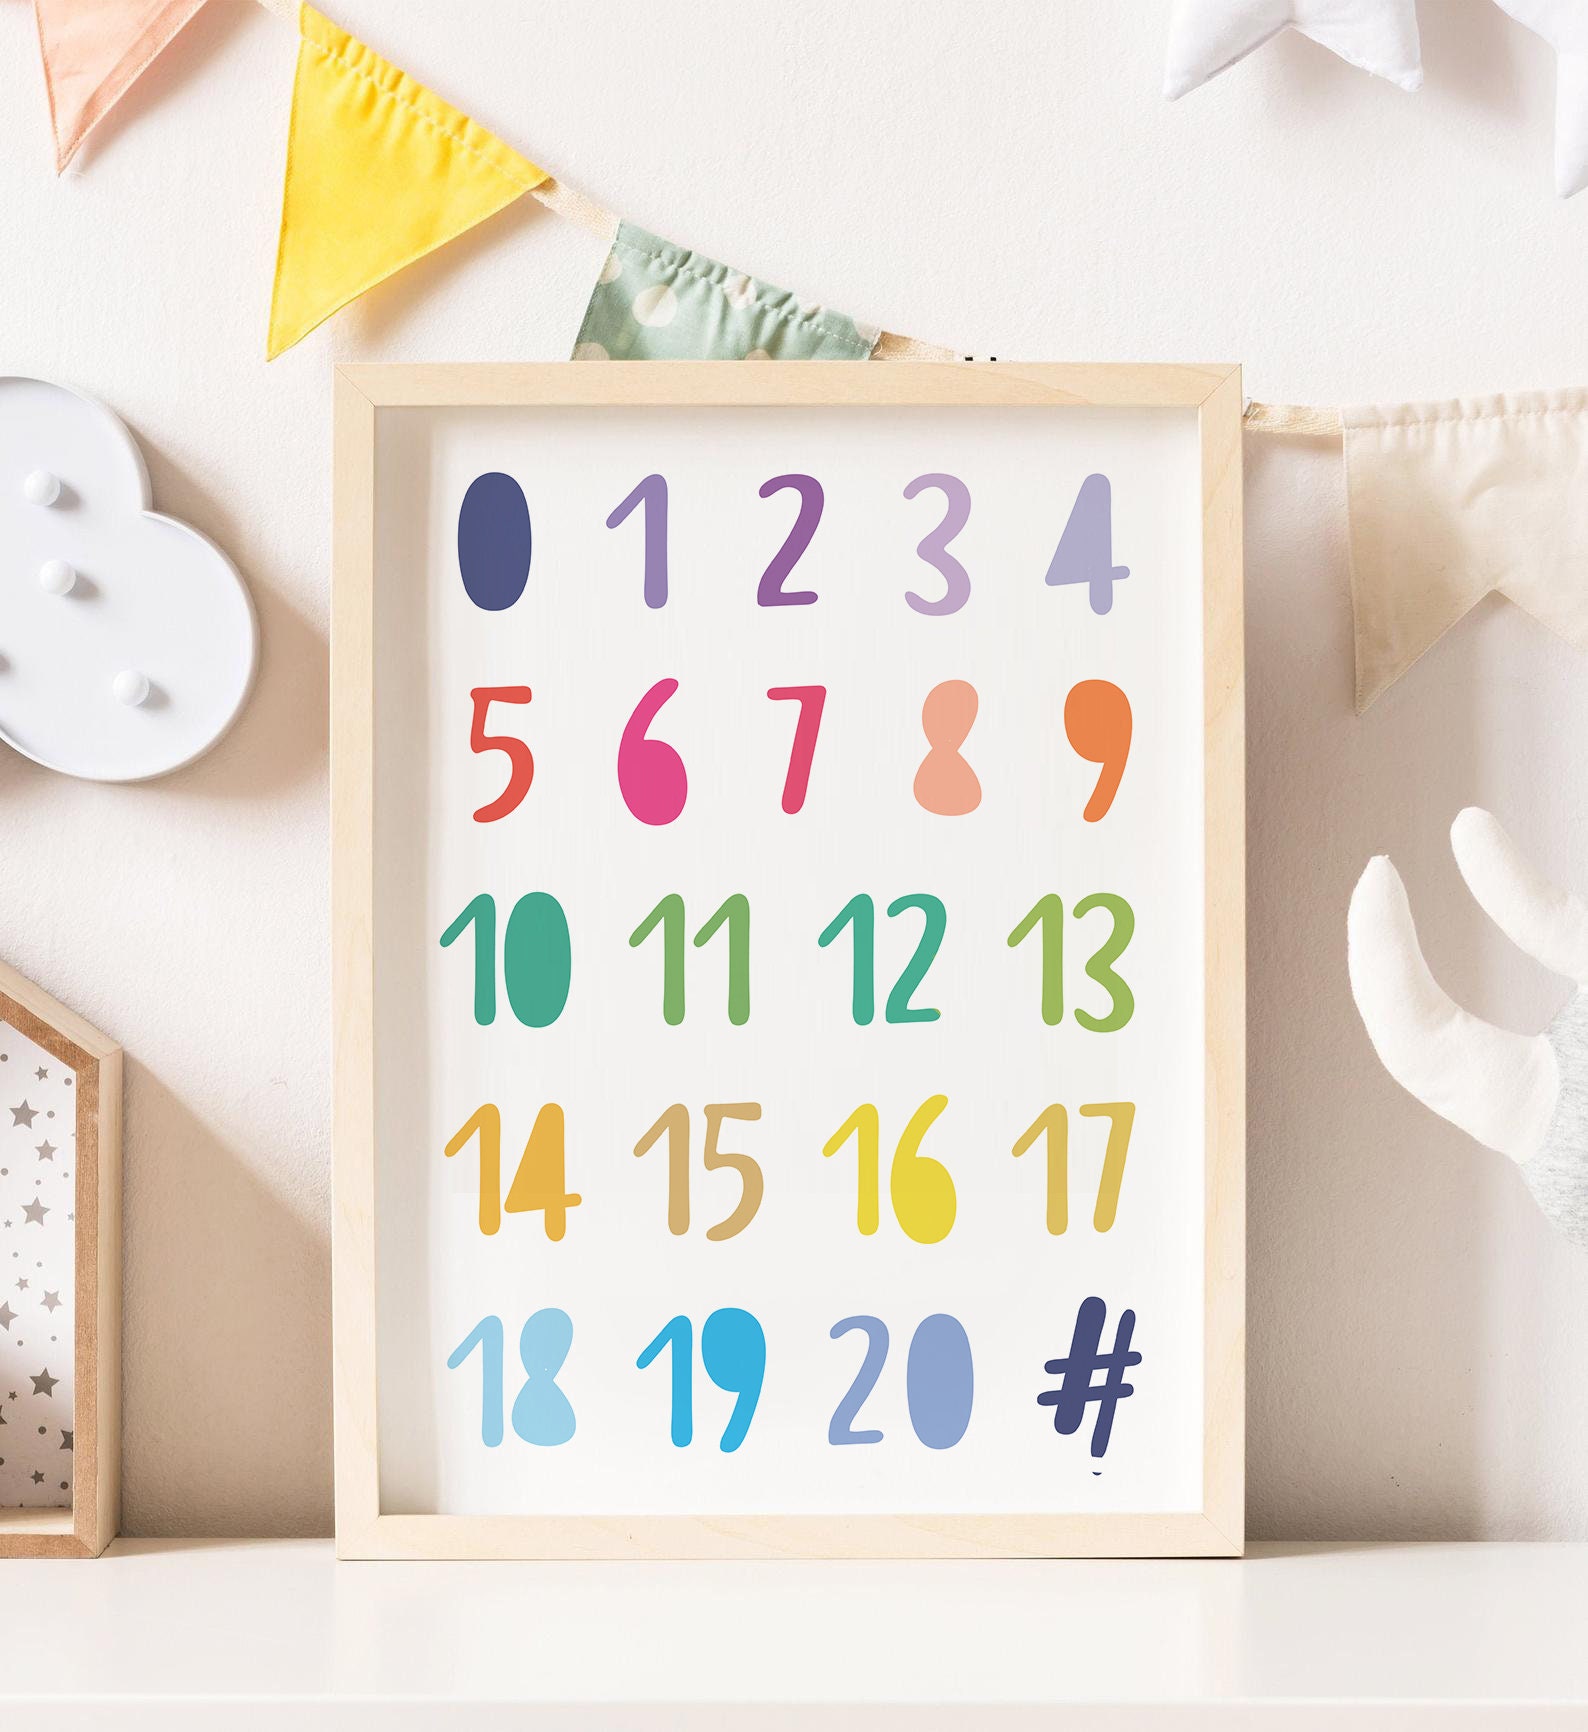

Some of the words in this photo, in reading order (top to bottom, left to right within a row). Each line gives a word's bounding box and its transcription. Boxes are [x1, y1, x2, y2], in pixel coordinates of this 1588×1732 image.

[458, 472, 531, 611] 0
[606, 474, 668, 608] 1
[757, 474, 824, 607] 2
[903, 474, 971, 616] 3
[1045, 473, 1131, 615] 4
[469, 685, 534, 823] 5
[617, 678, 688, 826] 6
[766, 685, 827, 815] 7
[913, 679, 982, 816] 8
[1063, 679, 1133, 823] 9
[440, 891, 572, 1028] 10
[629, 893, 750, 1026] 11
[818, 893, 947, 1026] 12
[1007, 893, 1135, 1033] 13
[444, 1102, 583, 1243] 14
[633, 1102, 764, 1242] 15
[821, 1093, 957, 1245] 16
[1011, 1101, 1136, 1236] 17
[446, 1307, 576, 1448] 18
[635, 1307, 767, 1453] 19
[828, 1313, 974, 1450] 20
[1037, 1297, 1142, 1457] #
